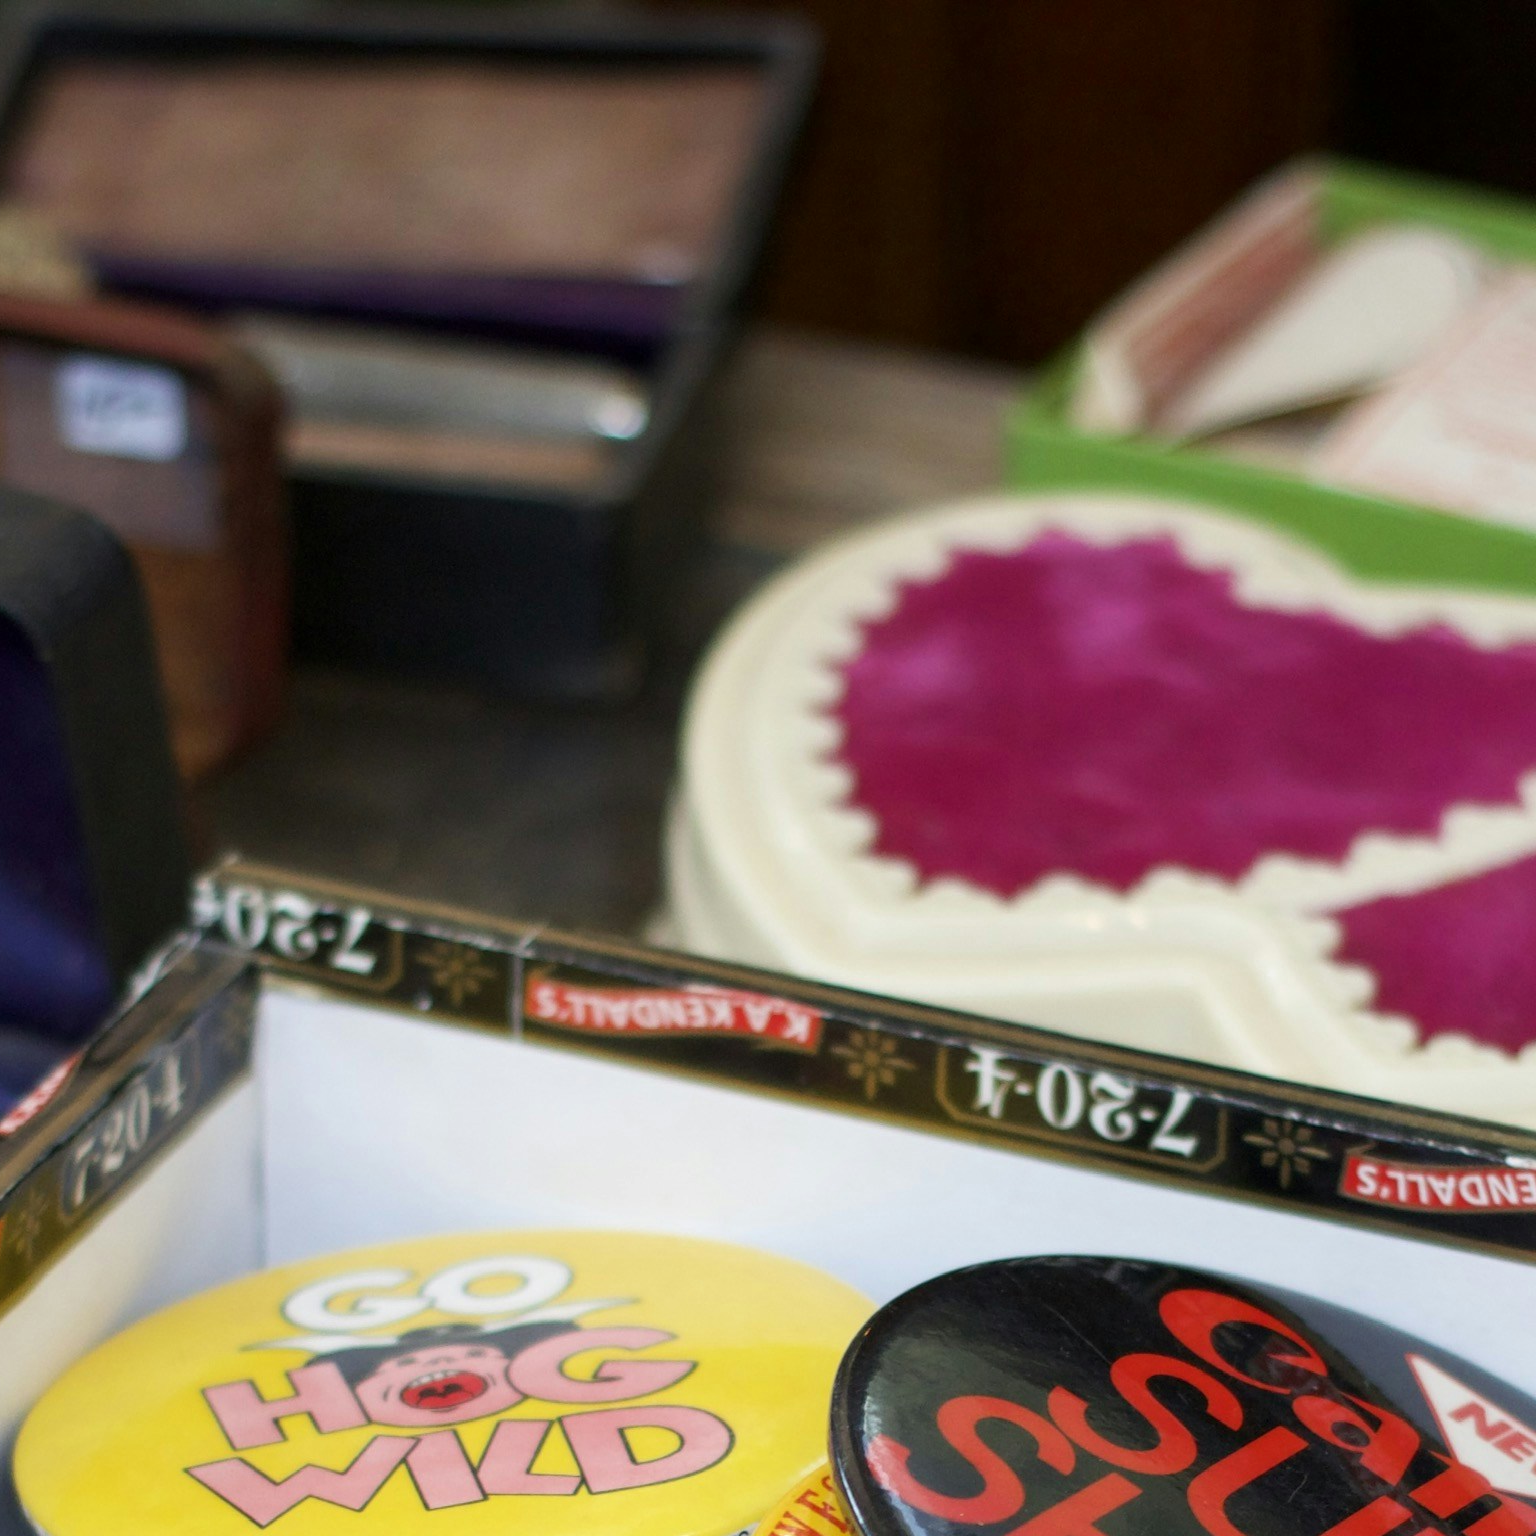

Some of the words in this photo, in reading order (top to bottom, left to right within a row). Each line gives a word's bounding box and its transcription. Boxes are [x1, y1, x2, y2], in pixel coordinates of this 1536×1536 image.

[965, 1044, 1202, 1158] 7-20-4
[281, 1255, 573, 1332] GO
[202, 1325, 701, 1452] HOG
[183, 1406, 737, 1529] WILD
